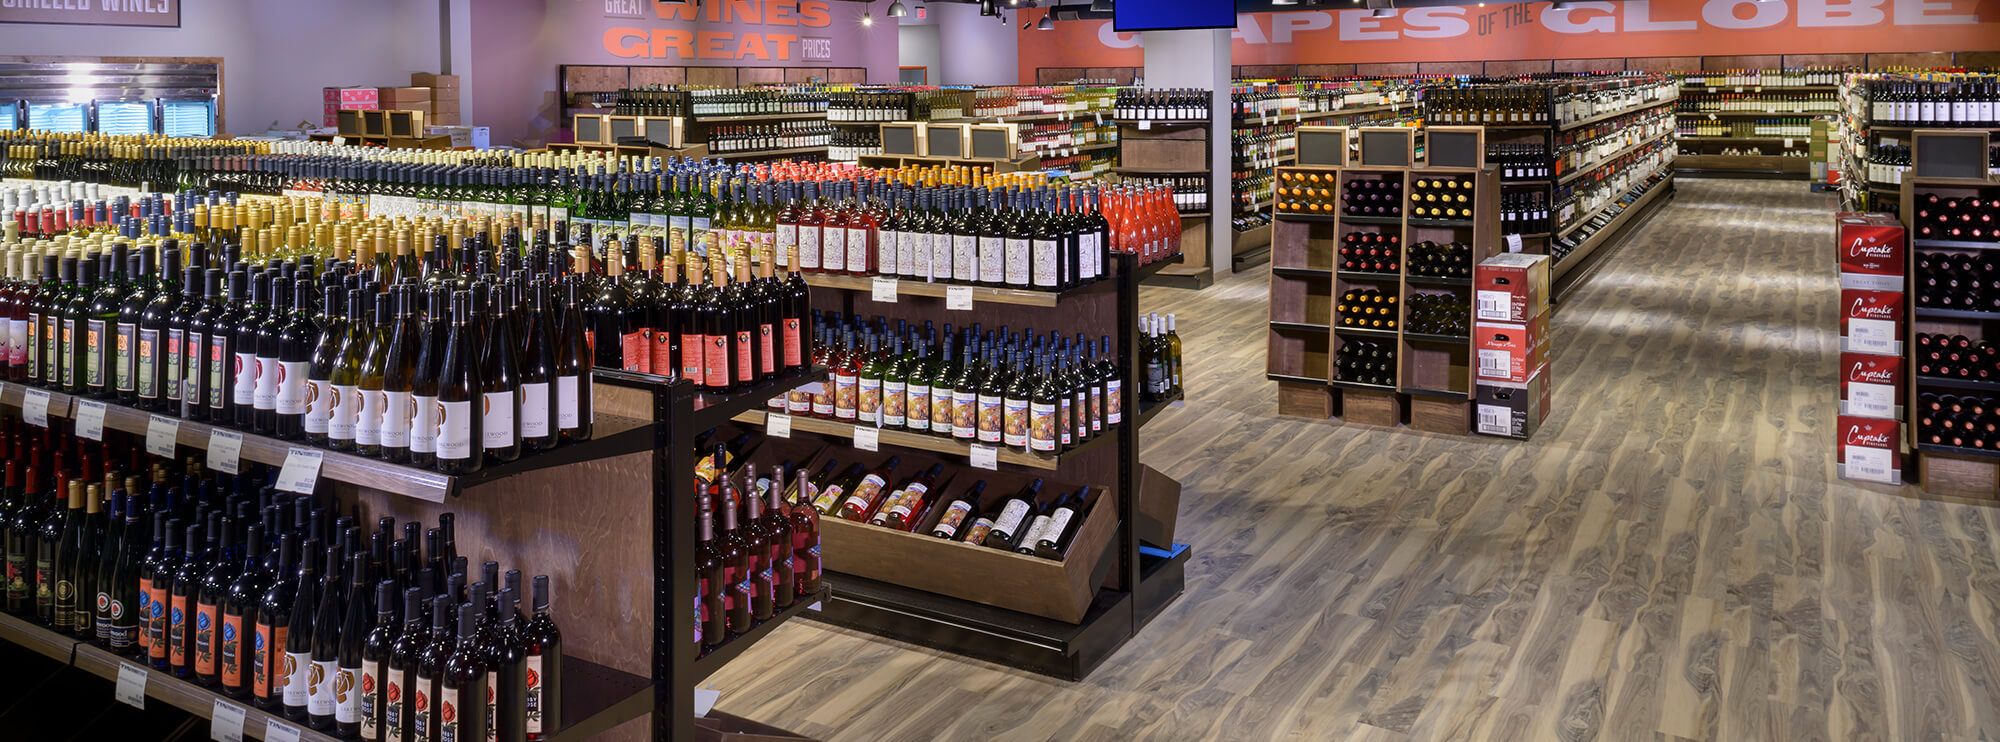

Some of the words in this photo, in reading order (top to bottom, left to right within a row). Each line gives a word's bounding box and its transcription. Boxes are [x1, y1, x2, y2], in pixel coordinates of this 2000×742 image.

[604, 0, 643, 15] GREAT
[653, 0, 832, 28] WINES
[1478, 14, 1497, 36] OF
[1504, 2, 1534, 28] THE
[1540, 0, 1980, 33] GLOBE
[602, 27, 798, 60] GREAT
[801, 39, 832, 59] PRICES
[1850, 237, 1893, 257] Cupcake
[1850, 297, 1893, 317] Cupcake
[1850, 361, 1893, 381] Cupcake
[1847, 425, 1889, 445] Cupcake
